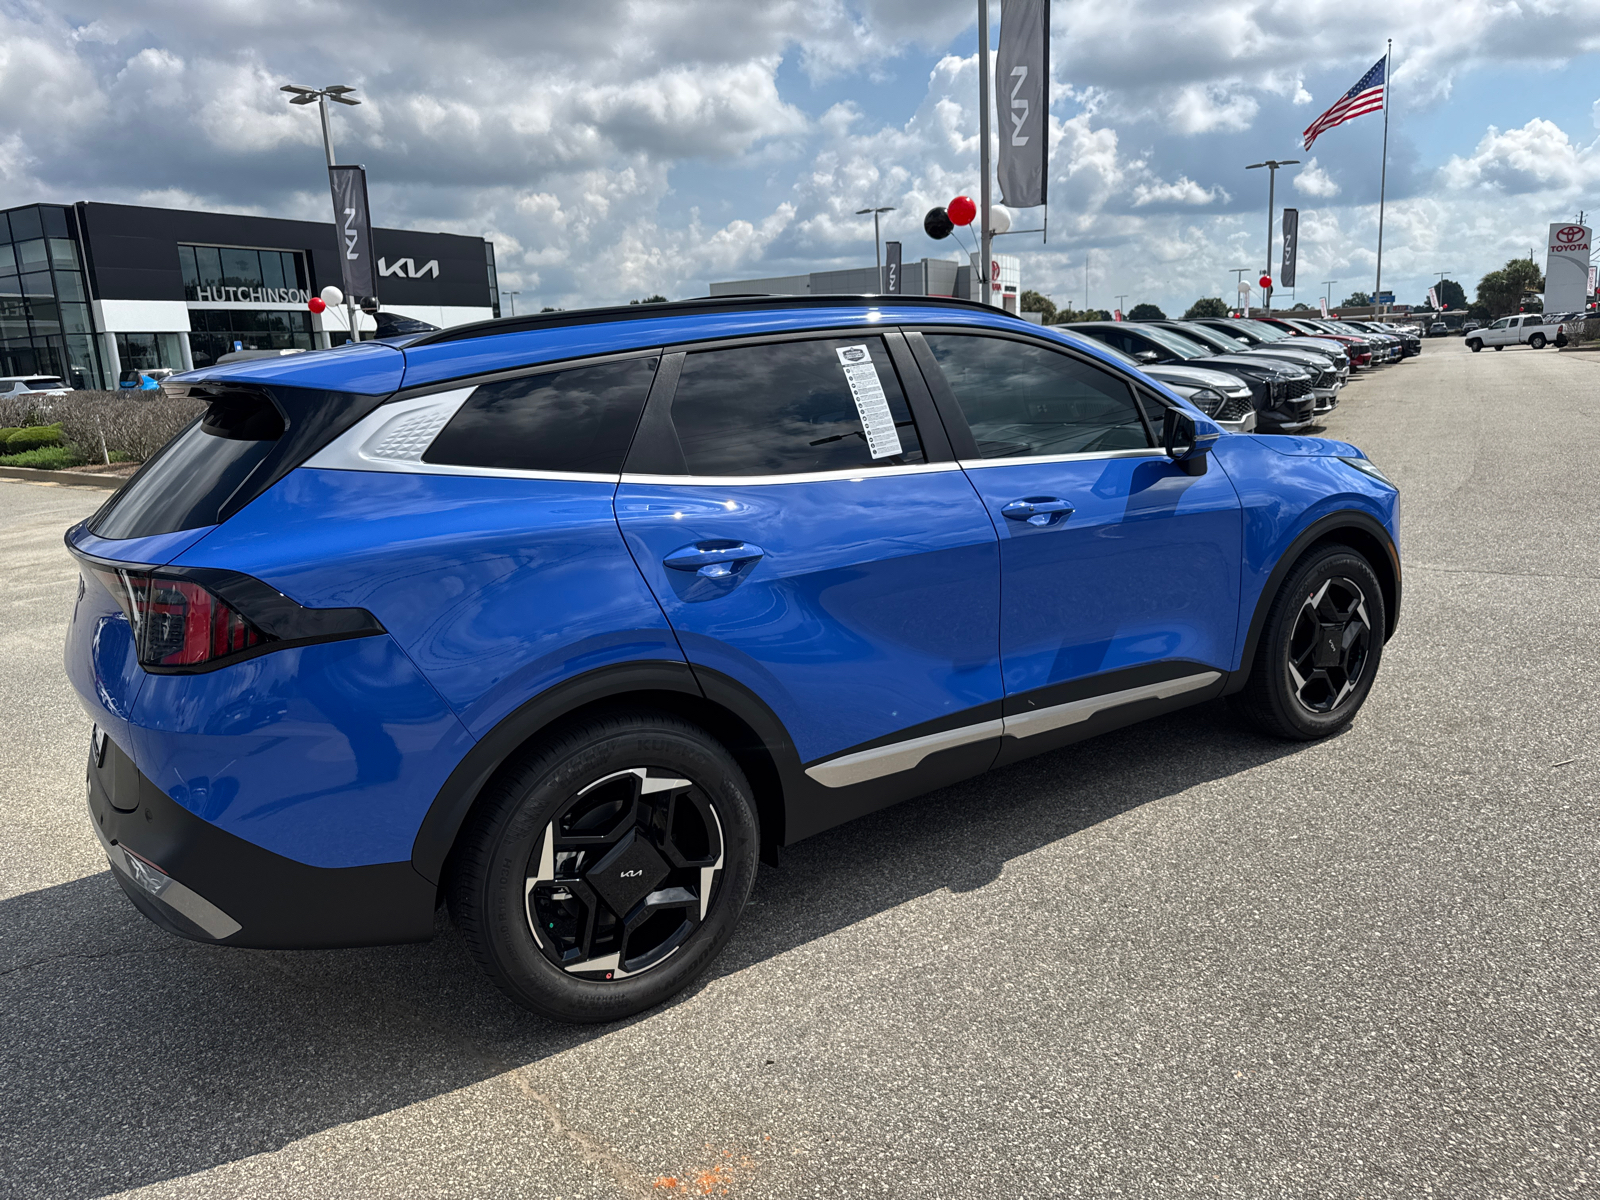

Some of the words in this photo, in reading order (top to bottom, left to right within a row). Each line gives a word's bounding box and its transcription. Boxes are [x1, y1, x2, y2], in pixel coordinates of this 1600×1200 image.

[1551, 243, 1589, 252] TOYOTA
[377, 256, 440, 279] KIA
[196, 286, 311, 304] HUTCHINSON
[620, 869, 643, 878] KIA
